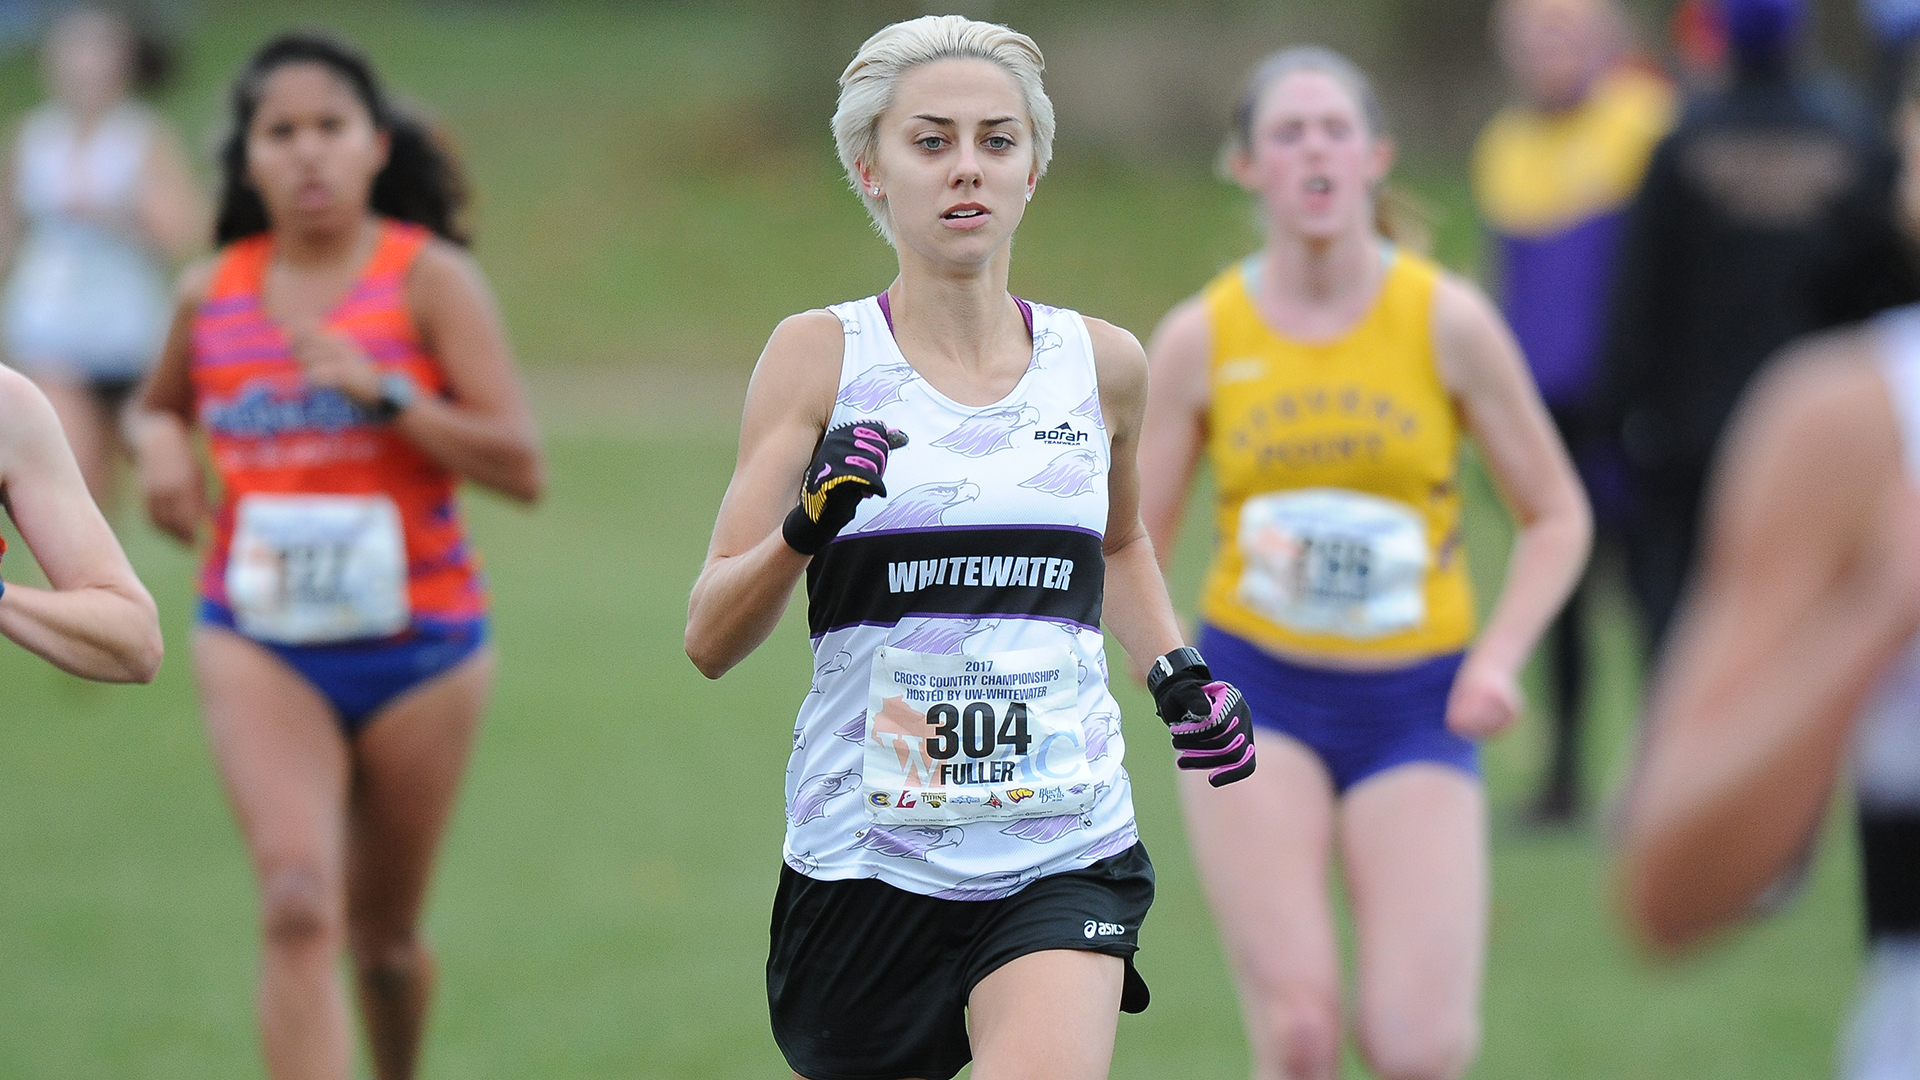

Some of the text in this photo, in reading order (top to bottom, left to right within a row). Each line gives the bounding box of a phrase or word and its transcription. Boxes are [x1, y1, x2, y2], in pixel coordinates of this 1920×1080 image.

[887, 555, 1074, 593] WHITEWATER
[965, 660, 994, 672] 2017
[894, 670, 1059, 688] CROSS COUNTRY CHAMPIONSHIPS
[906, 687, 1047, 702] HOSTED BY UW-WHITEWATER
[926, 701, 1032, 760] 304
[940, 760, 1016, 785] FULLER
